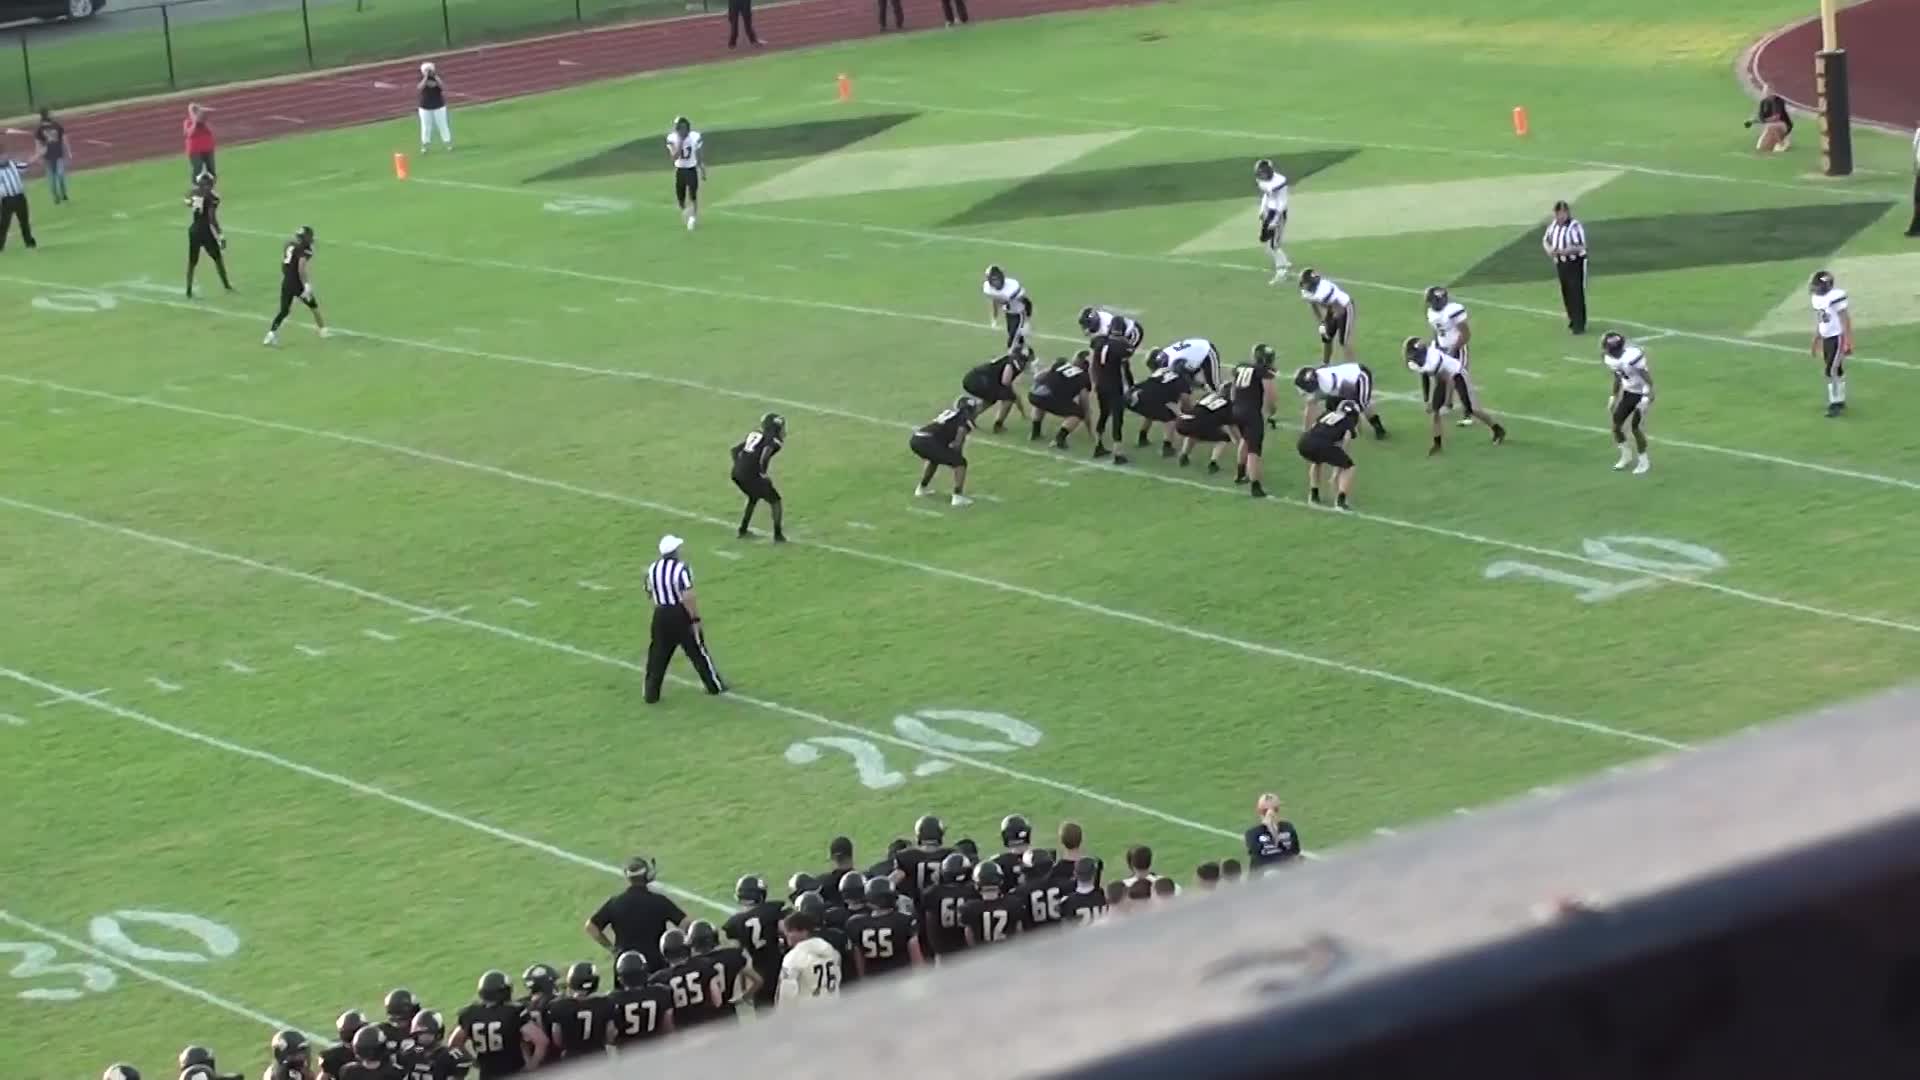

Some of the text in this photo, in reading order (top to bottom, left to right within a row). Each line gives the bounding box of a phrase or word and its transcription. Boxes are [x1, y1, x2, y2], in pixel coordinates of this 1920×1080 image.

[1100, 344, 1109, 365] 1
[1235, 366, 1254, 388] 70
[1484, 535, 1729, 602] 10
[784, 709, 1043, 790] 20
[745, 918, 766, 949] 2
[983, 910, 1008, 941] 12
[0, 910, 241, 1000] 30
[862, 928, 894, 958] 55
[670, 972, 704, 1009] 65
[813, 961, 839, 998] 76
[577, 1010, 593, 1040] 7
[625, 1000, 657, 1035] 57
[472, 1021, 503, 1053] 56
